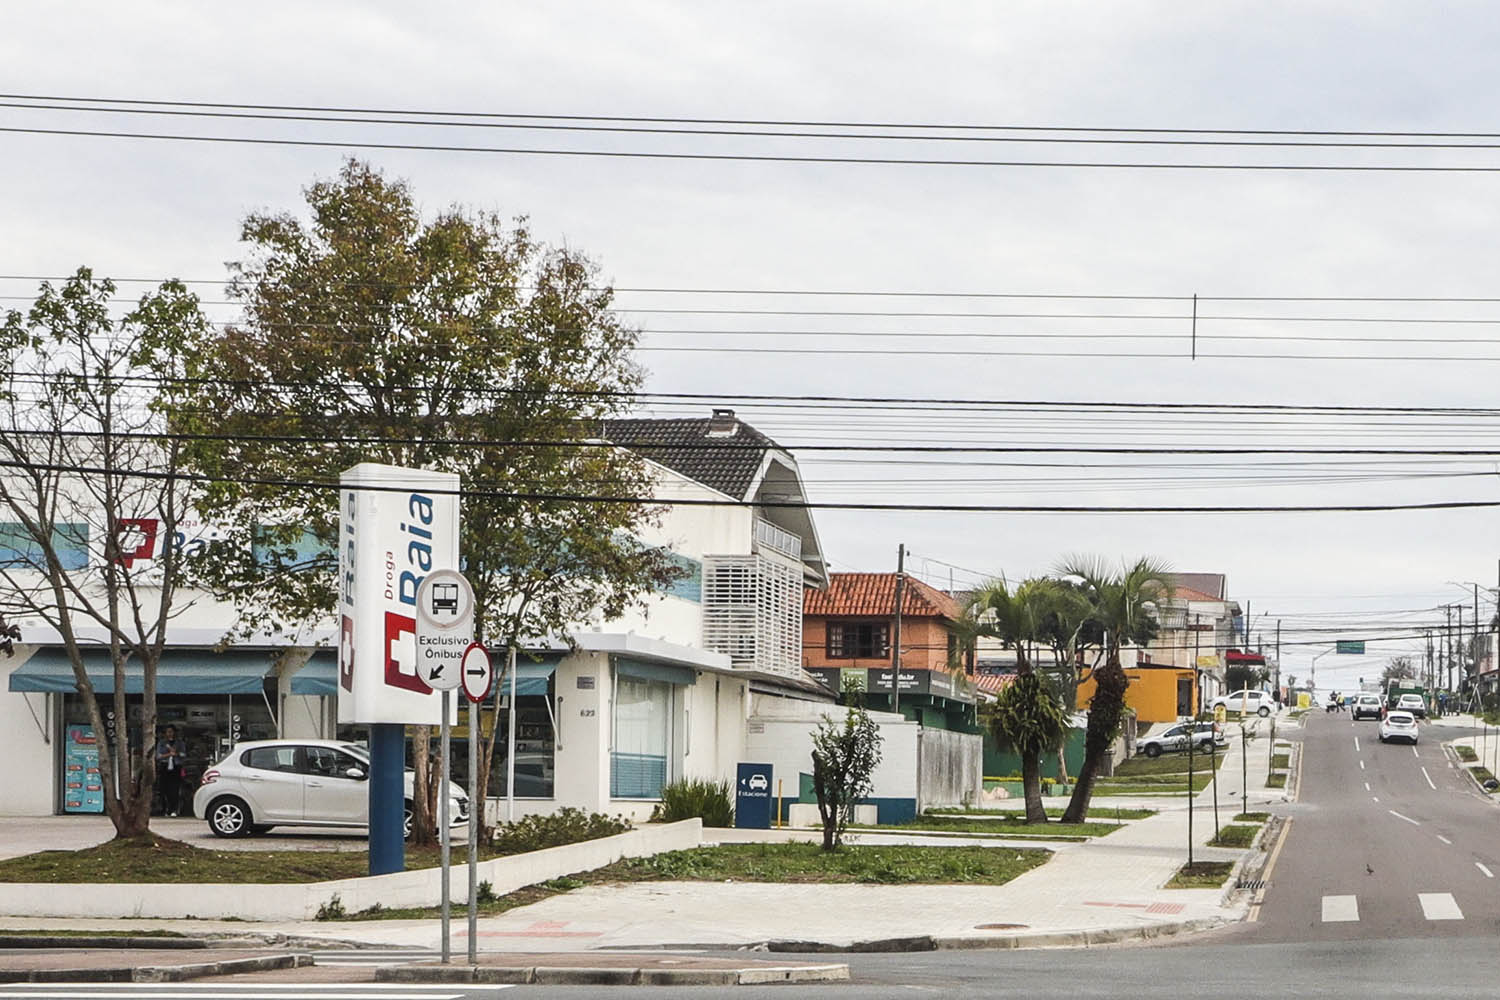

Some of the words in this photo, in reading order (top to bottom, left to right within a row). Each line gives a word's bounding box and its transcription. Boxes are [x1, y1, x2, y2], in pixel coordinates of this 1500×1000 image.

[400, 493, 433, 606] Raia
[385, 551, 395, 600] Droga
[420, 636, 469, 646] Exclusivo
[426, 647, 463, 659] Ônibus
